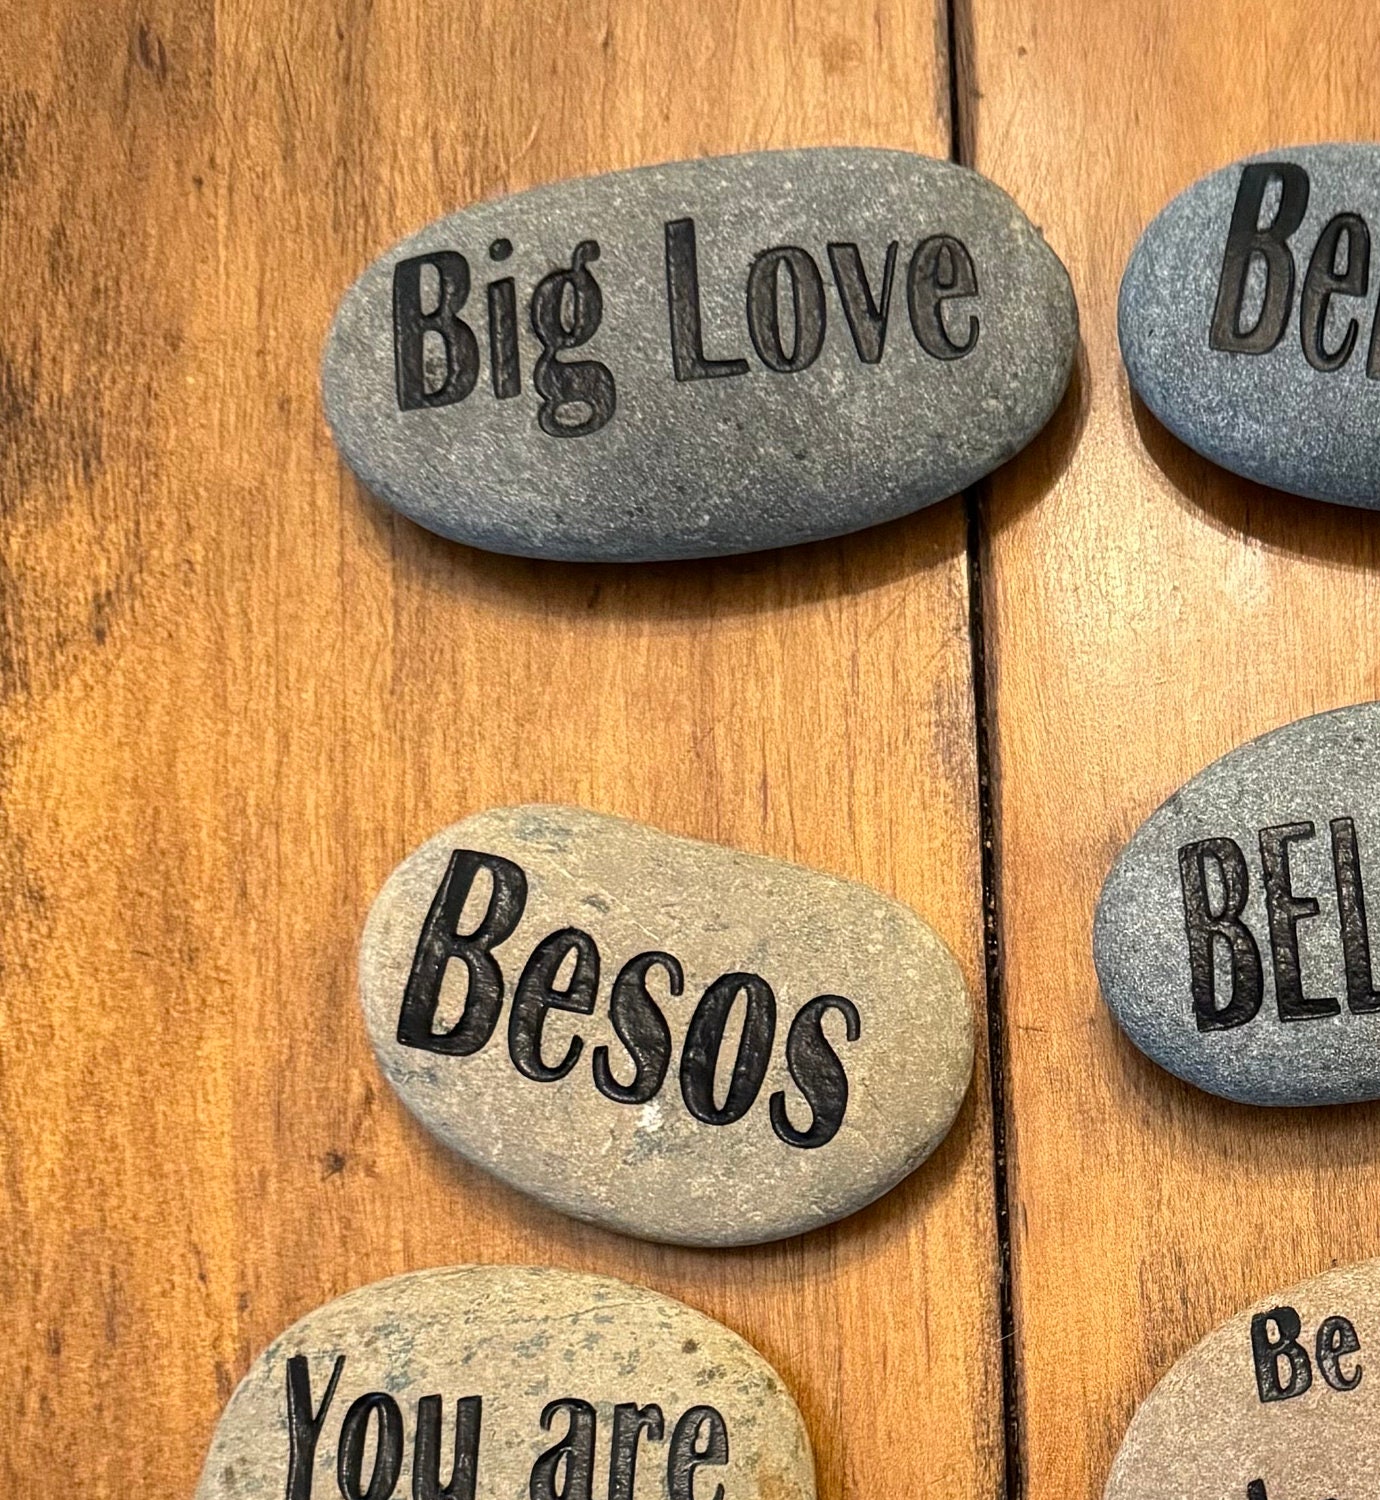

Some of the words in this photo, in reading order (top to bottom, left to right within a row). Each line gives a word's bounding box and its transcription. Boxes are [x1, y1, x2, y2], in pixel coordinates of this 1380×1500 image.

[392, 238, 617, 439] Big
[664, 217, 980, 385] Love
[396, 849, 861, 1149] Besos
[1251, 1306, 1363, 1403] Be
